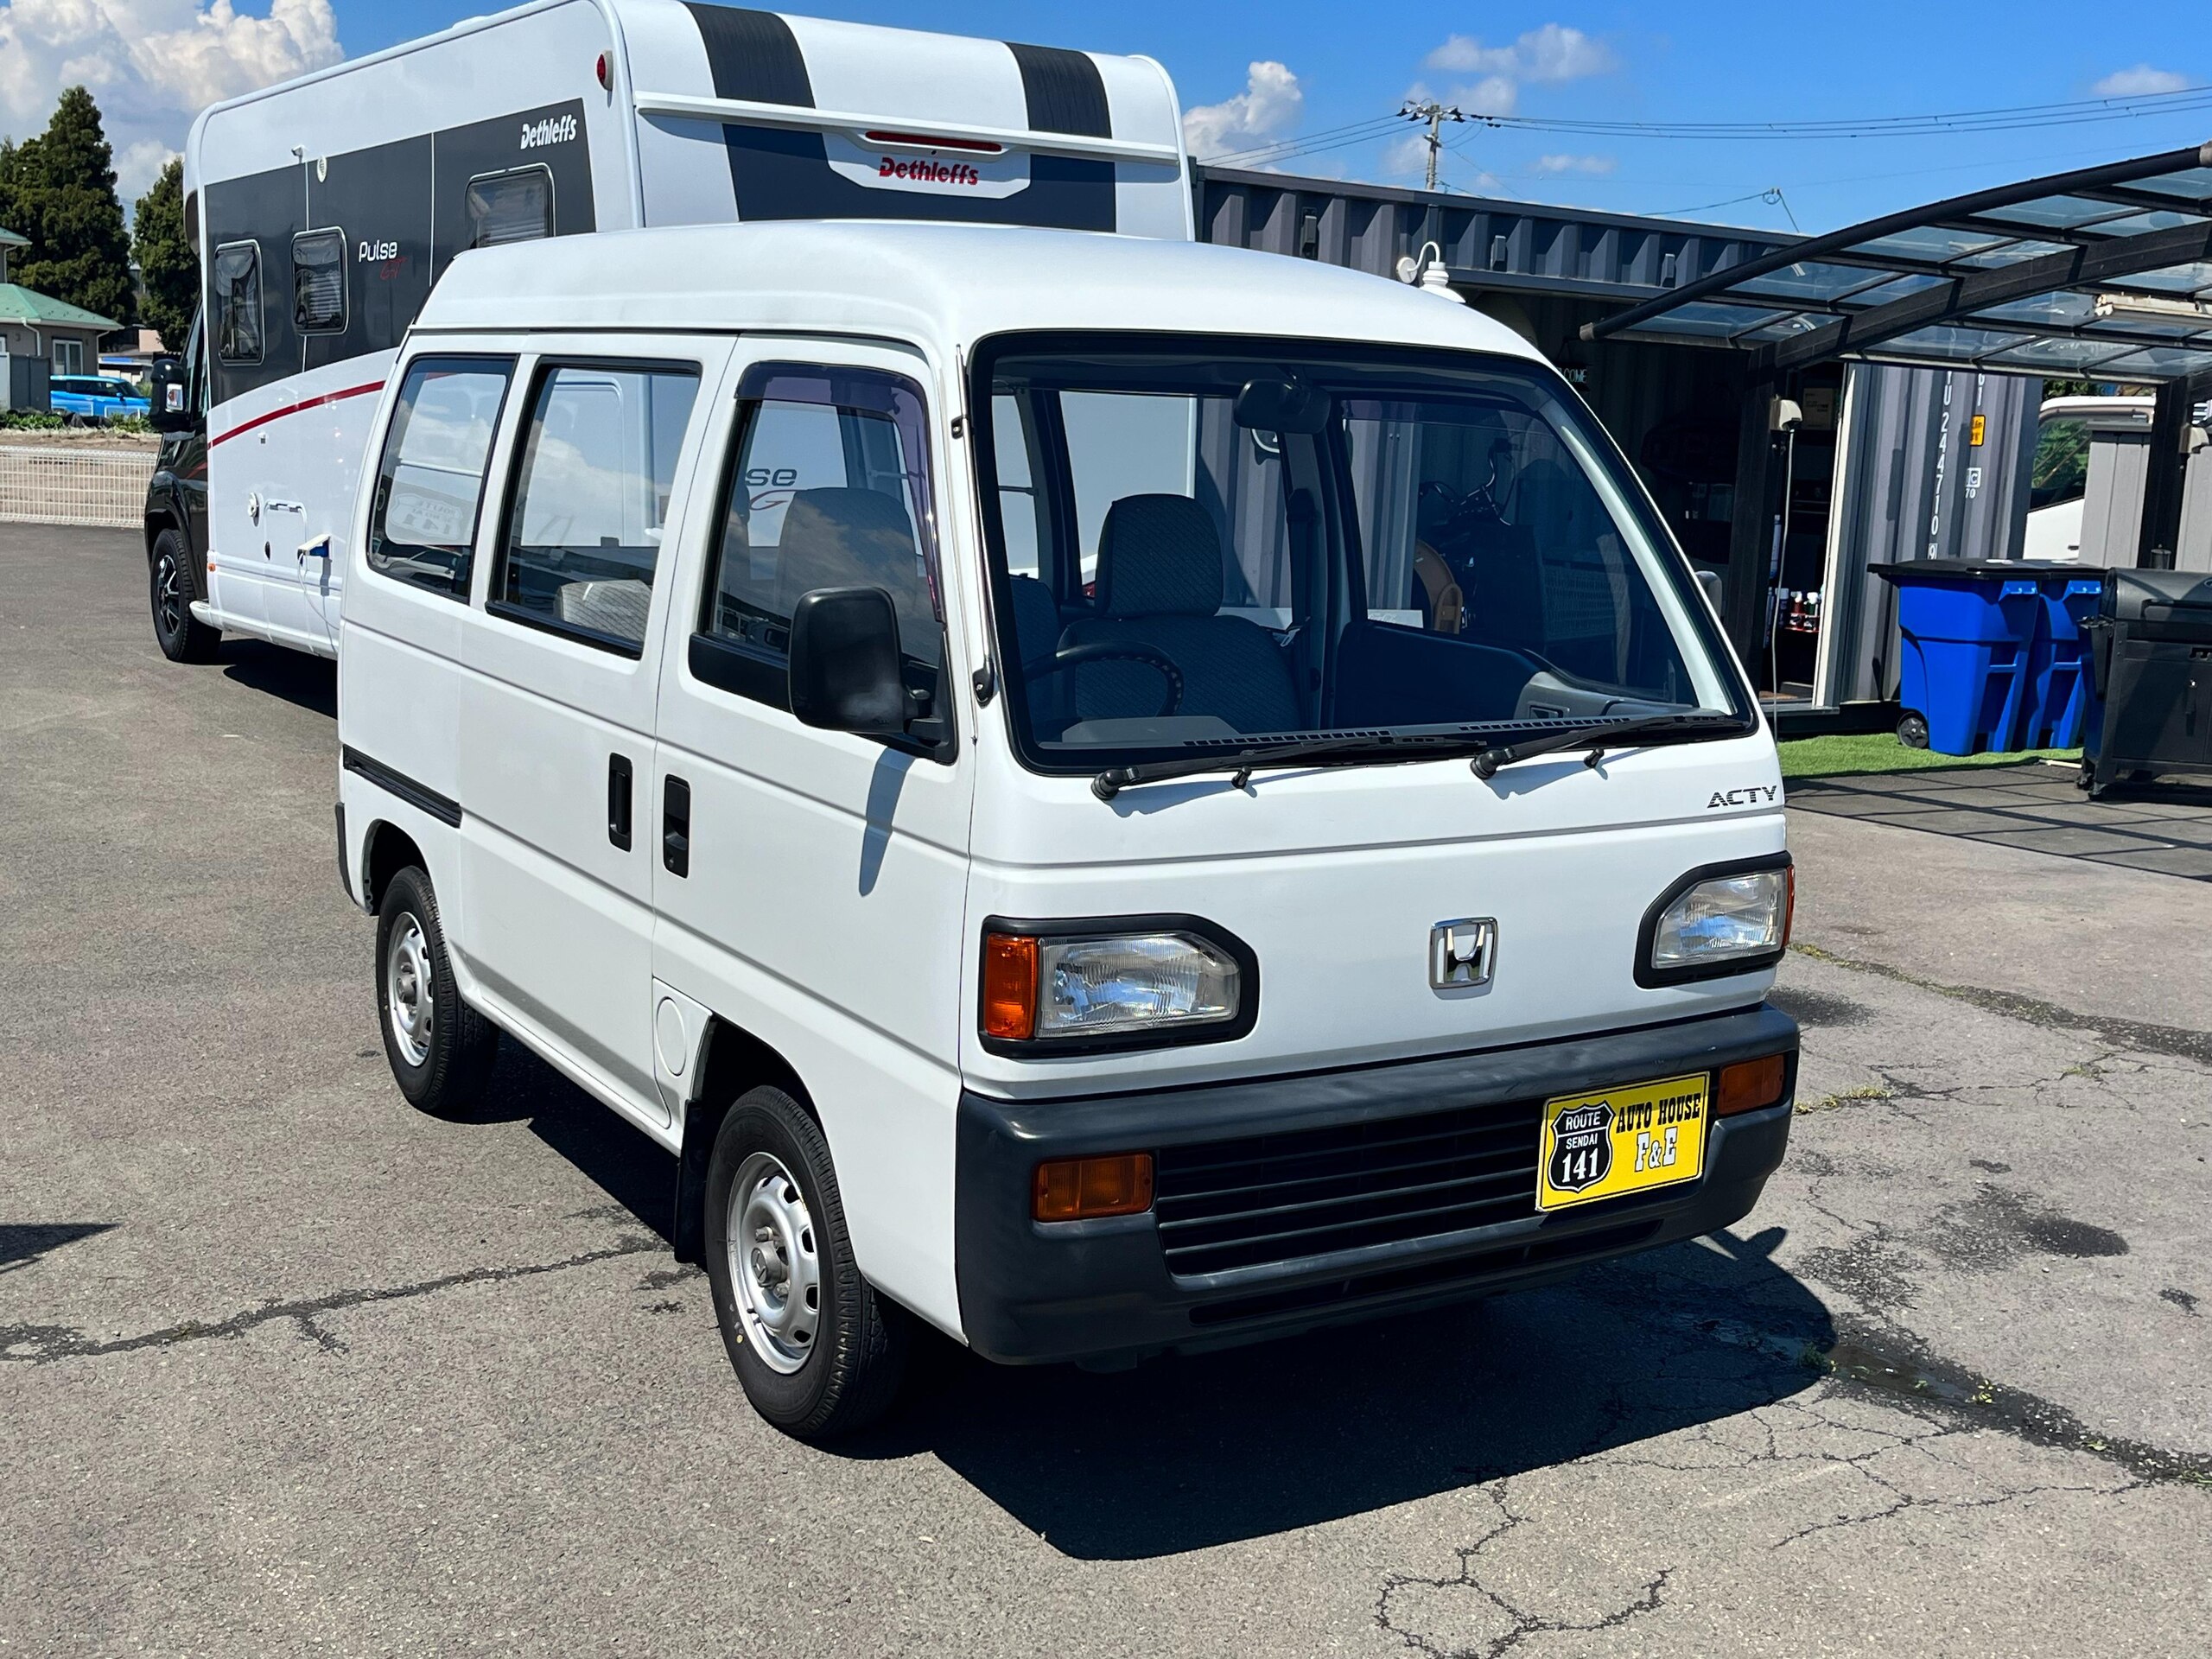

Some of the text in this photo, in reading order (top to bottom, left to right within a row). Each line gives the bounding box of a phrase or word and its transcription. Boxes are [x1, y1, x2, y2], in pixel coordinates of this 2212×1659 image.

[520, 114, 577, 149] Dethleffs
[879, 156, 979, 186] Dethleffs
[359, 239, 397, 263] Pulse
[745, 468, 798, 486] se
[1707, 785, 1777, 809] ACTY
[1565, 1111, 1601, 1131] ROUTE
[1616, 1093, 1701, 1134] AUTO HOUSE
[1566, 1133, 1599, 1150] SENDAI
[1634, 1126, 1678, 1173] F&E
[1561, 1147, 1599, 1183] 141
